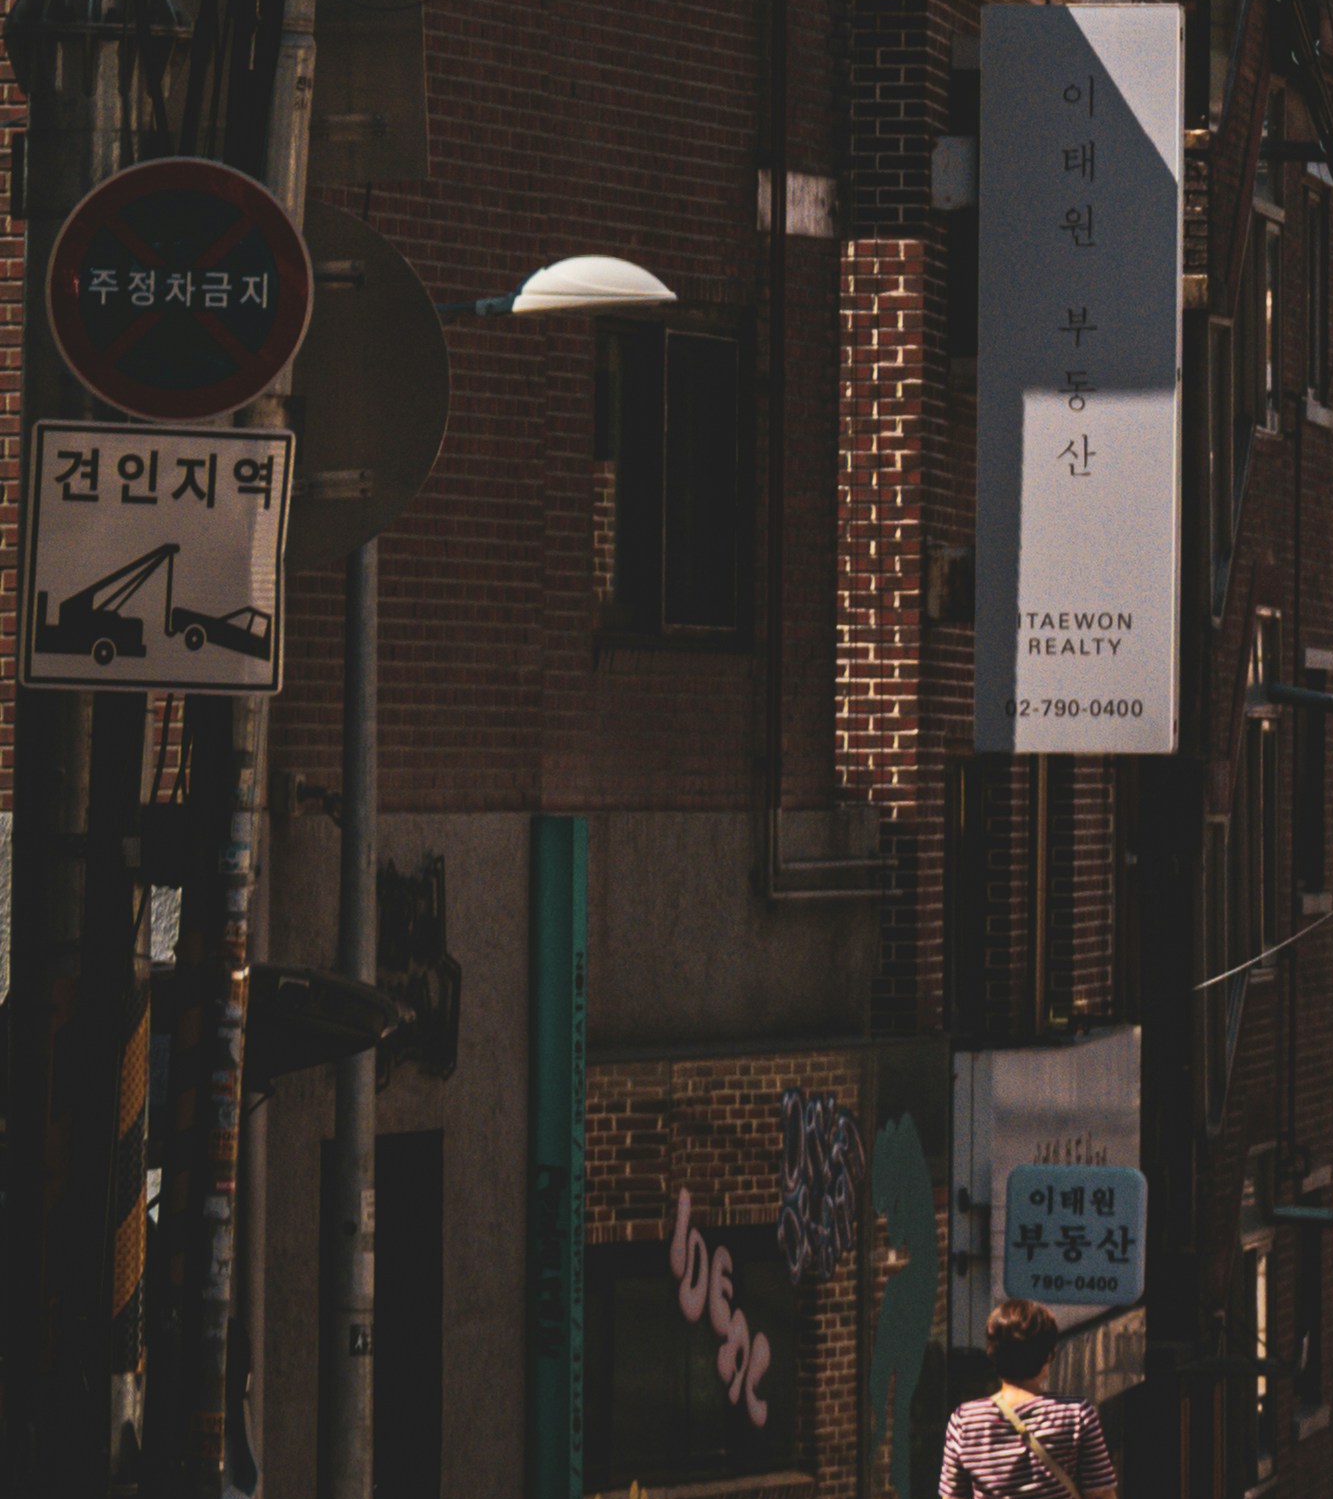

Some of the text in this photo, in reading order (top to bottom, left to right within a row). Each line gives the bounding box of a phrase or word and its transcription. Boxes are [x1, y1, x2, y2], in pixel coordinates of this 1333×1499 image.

[88, 267, 271, 310] 주정차금지
[1058, 75, 1098, 480] 이태원 부동산
[54, 449, 274, 511] 견인지역
[1017, 612, 1133, 630] ITAEWON
[1028, 637, 1122, 656] REALTY
[1005, 699, 1143, 718] 02-790-0400
[574, 951, 584, 1126] INSPIRATION
[1029, 1185, 1115, 1217] 이태원
[1012, 1223, 1136, 1266] 부동산
[1031, 1274, 1119, 1293] 790-0400
[669, 1186, 772, 1428] IDEAL
